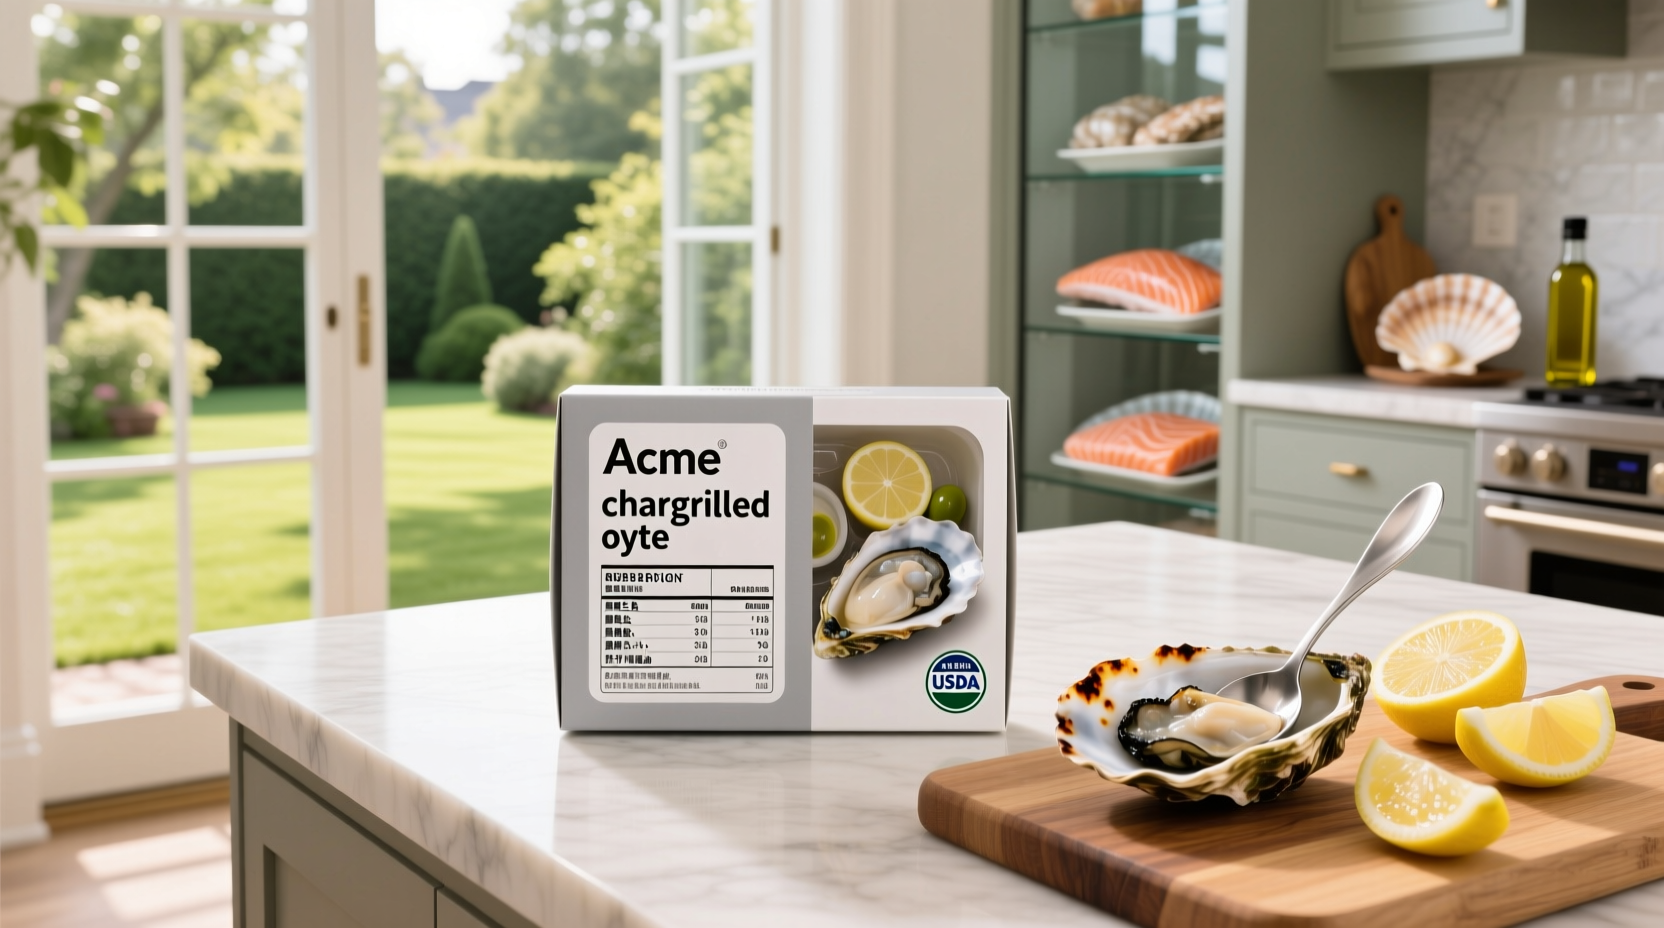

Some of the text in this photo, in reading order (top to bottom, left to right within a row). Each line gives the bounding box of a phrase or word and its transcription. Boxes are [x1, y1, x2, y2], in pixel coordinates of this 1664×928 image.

[602, 438, 721, 476] Acme
[601, 489, 770, 527] chargrilled
[601, 525, 670, 558] oyte
[932, 674, 981, 691] USDA
